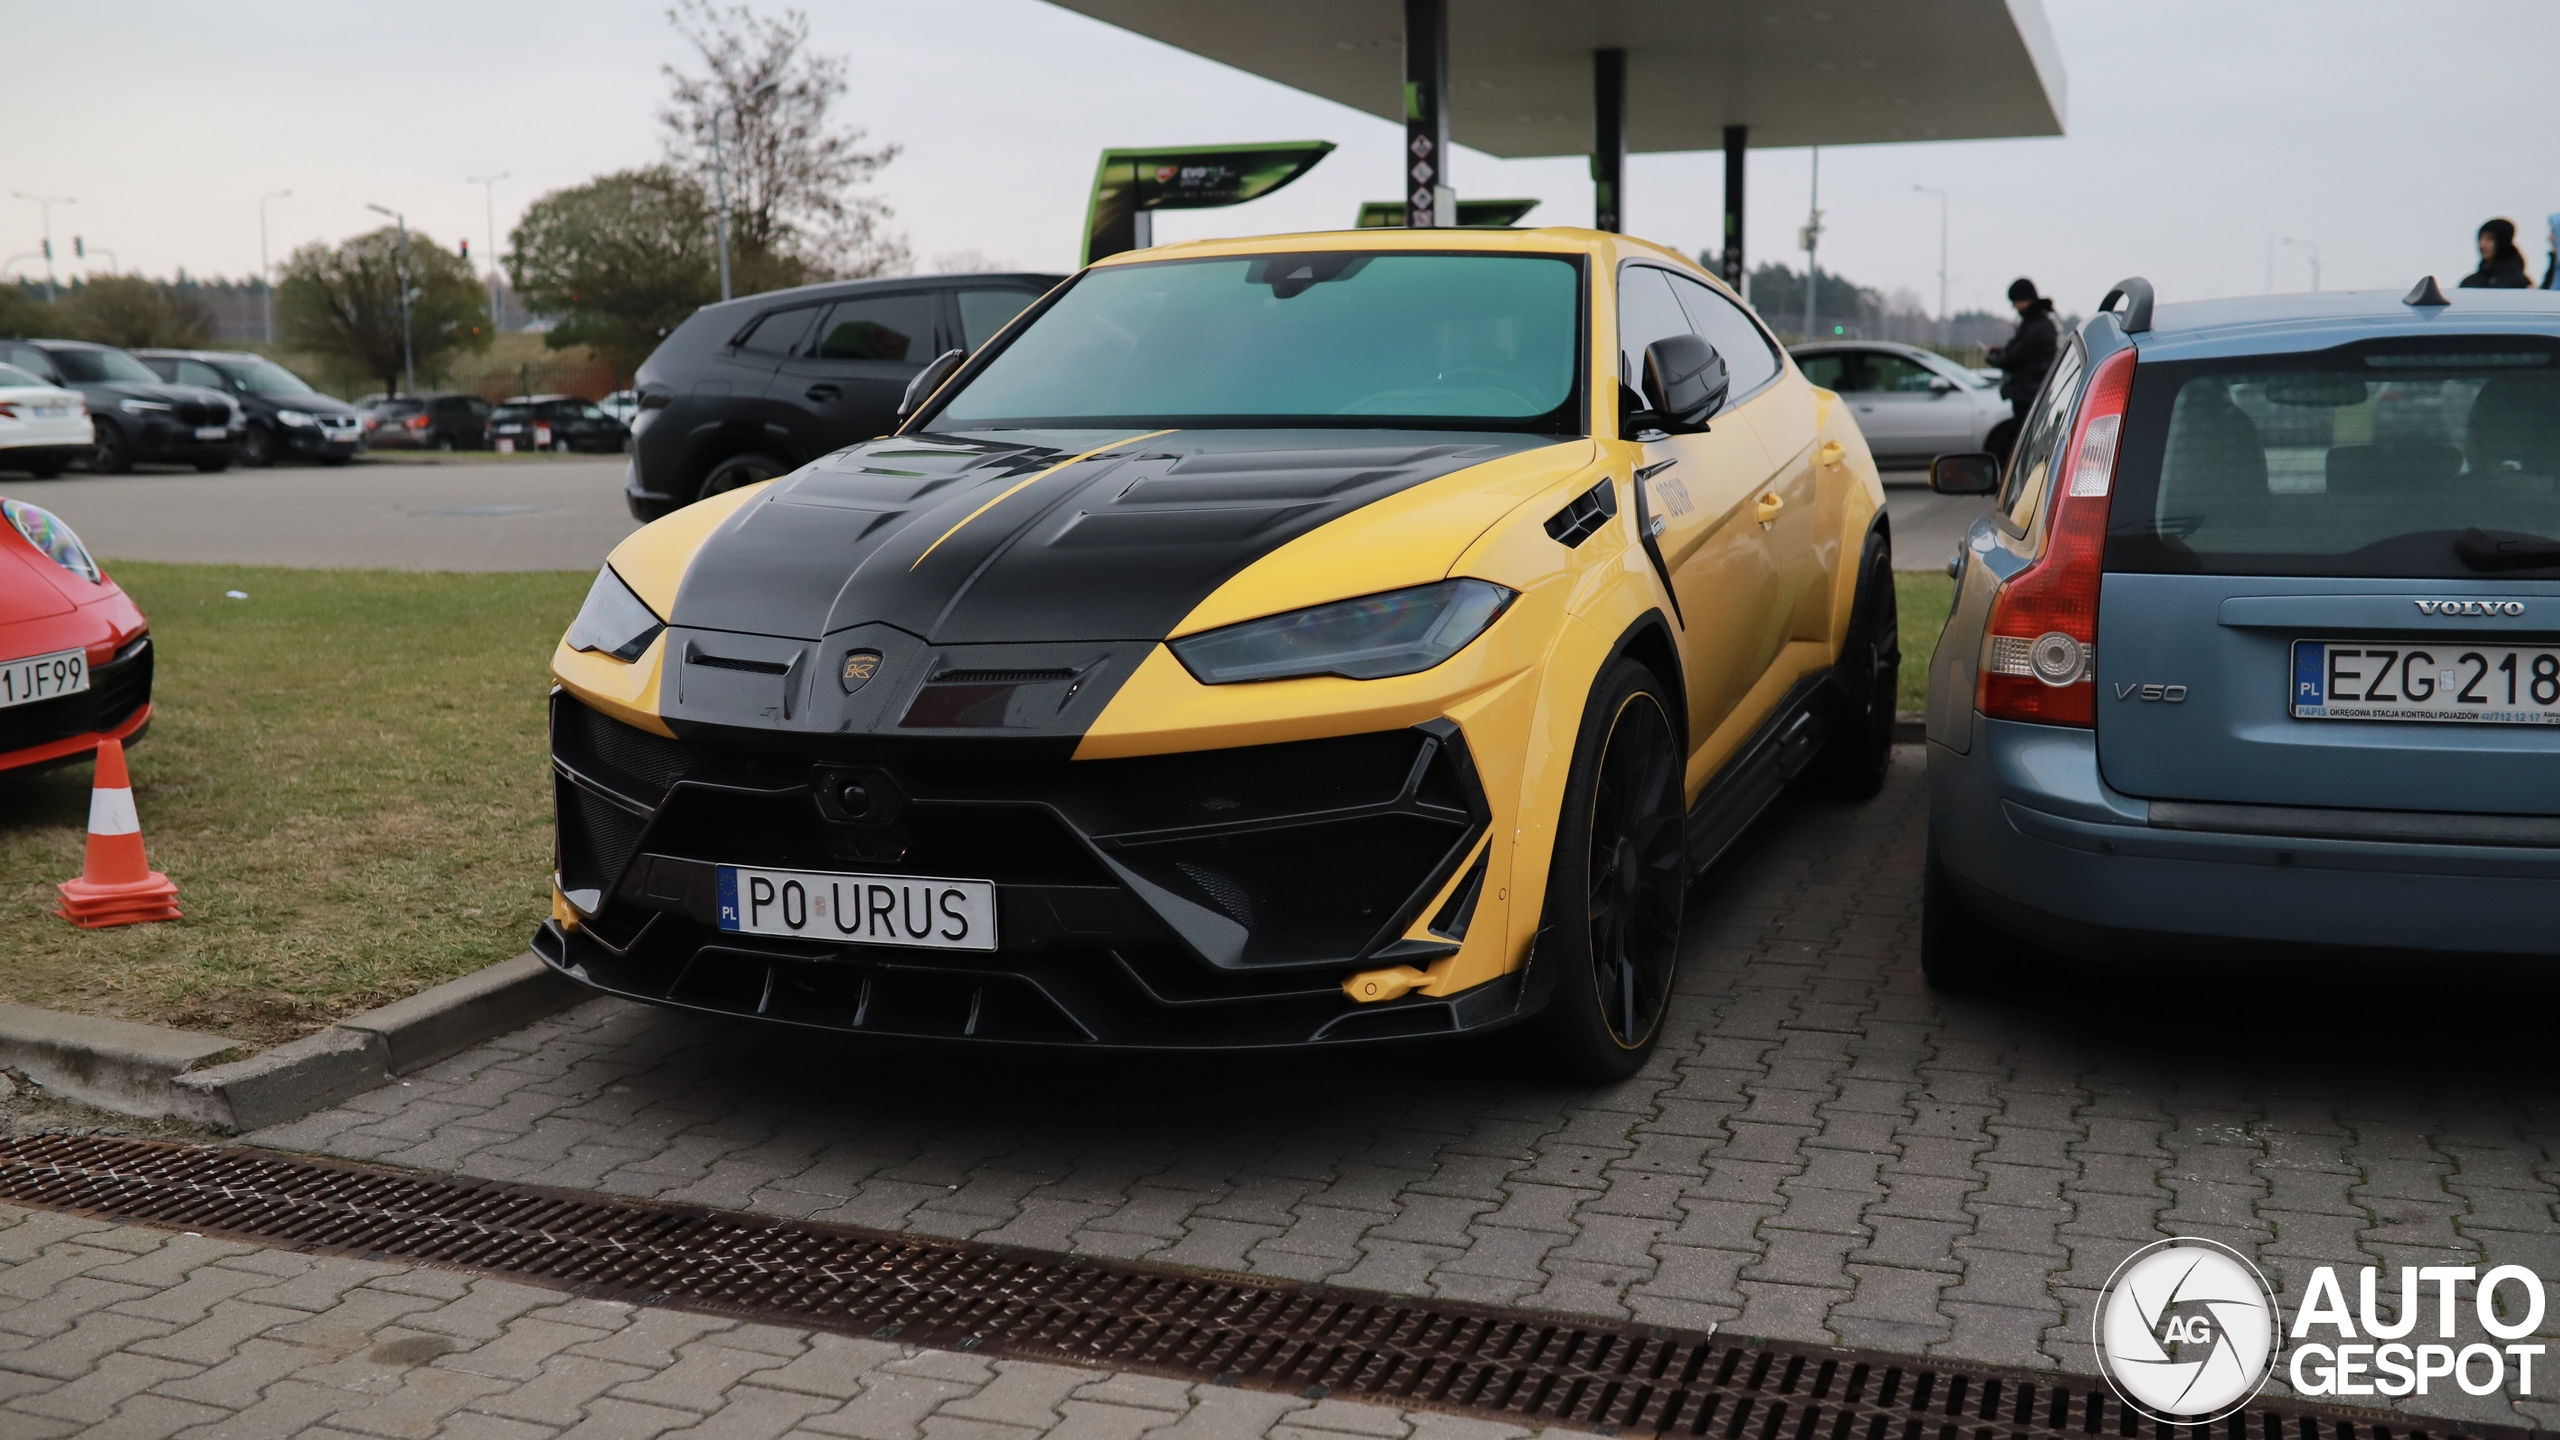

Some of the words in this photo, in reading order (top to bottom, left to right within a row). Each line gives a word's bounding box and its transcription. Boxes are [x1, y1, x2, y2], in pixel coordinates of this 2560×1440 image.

[2414, 600, 2525, 617] VOLVO
[2, 657, 82, 702] 1JF99
[2329, 649, 2435, 702] EZG
[2456, 652, 2560, 705] 218
[2300, 682, 2319, 697] PL
[2298, 707, 2327, 717] PAPIS
[2329, 708, 2371, 718] OKRĘGOWA
[2372, 710, 2400, 718] STACJA
[2401, 711, 2438, 719] KONTROLI
[2439, 710, 2480, 720] POJAZDÓW
[2514, 712, 2526, 722] 12
[2528, 713, 2541, 722] 17
[722, 906, 737, 921] PL
[832, 882, 969, 941] URUS
